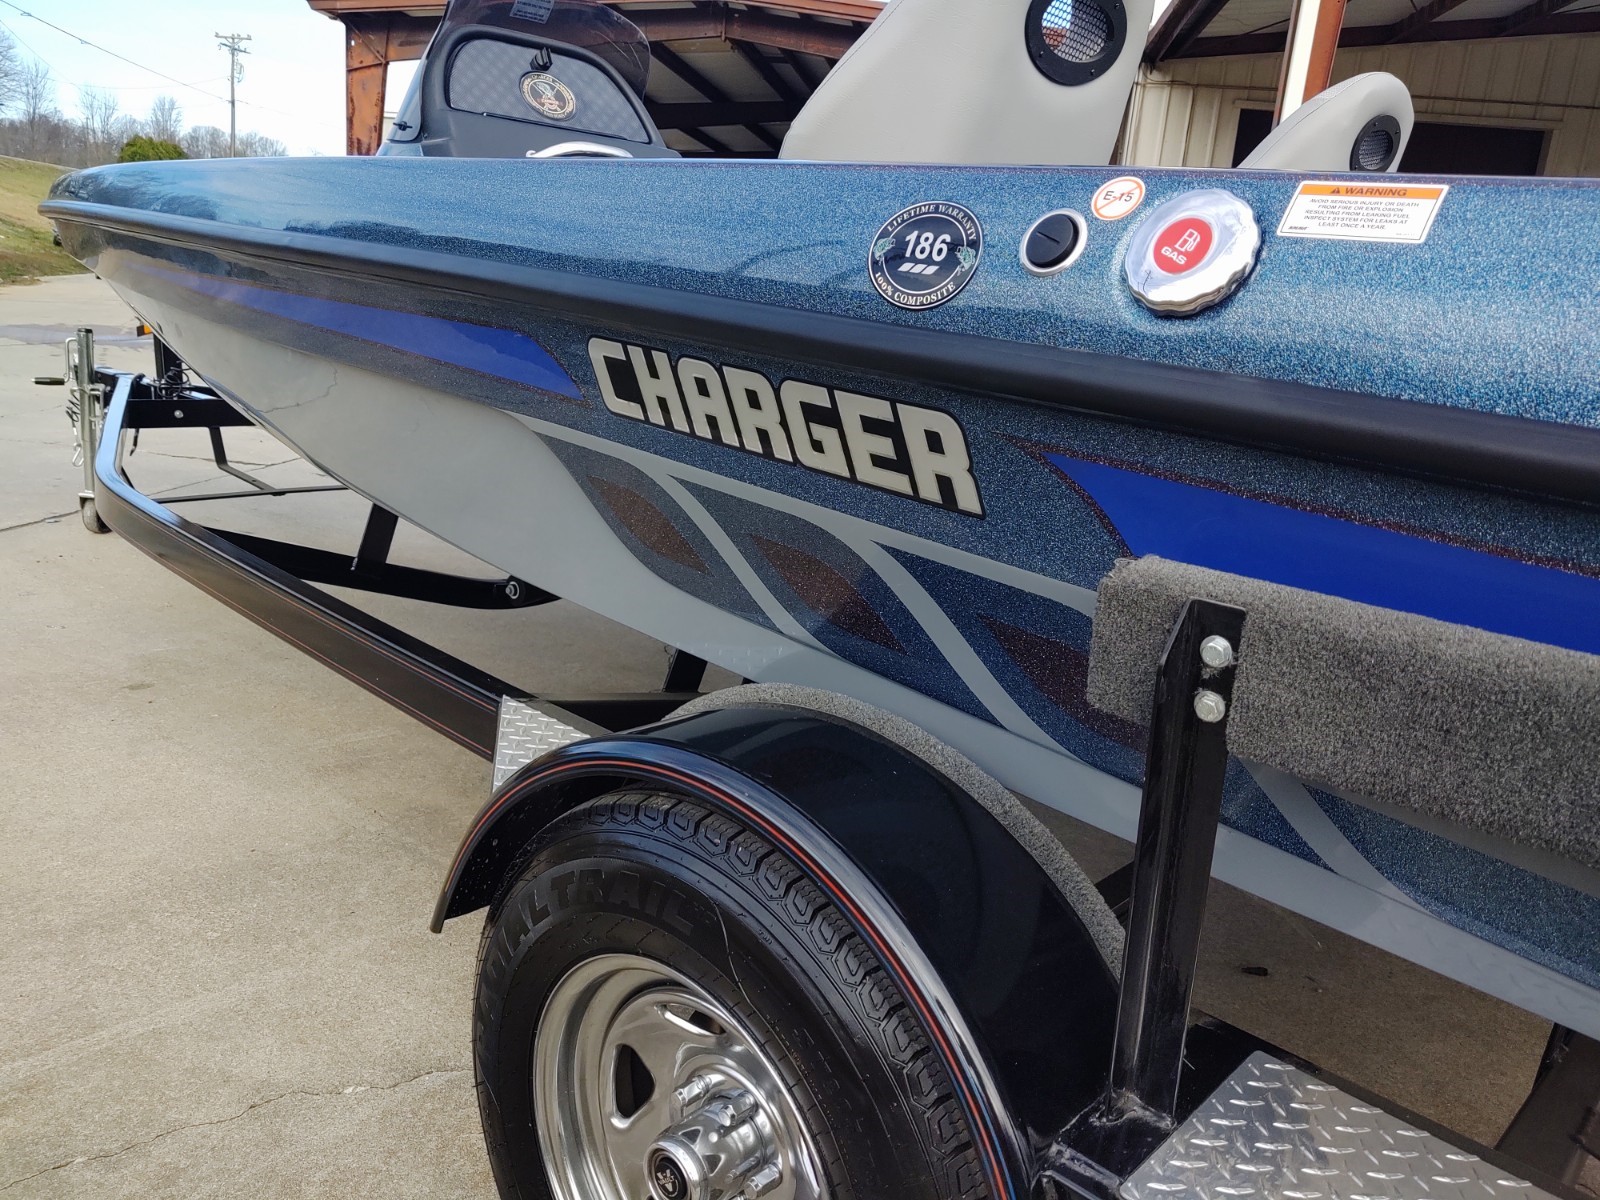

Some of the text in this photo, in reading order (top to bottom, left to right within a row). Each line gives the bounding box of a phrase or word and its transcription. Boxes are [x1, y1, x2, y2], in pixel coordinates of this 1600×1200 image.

[1103, 190, 1134, 202] E-15
[1344, 187, 1408, 197] WARNING
[887, 204, 977, 240] LIFETIME WARRANTY
[905, 230, 951, 262] 186
[1161, 246, 1187, 265] GAS
[875, 272, 956, 305] 100% COMPOSITE
[588, 336, 984, 516] CHARGER
[551, 870, 695, 937] TRAIL
